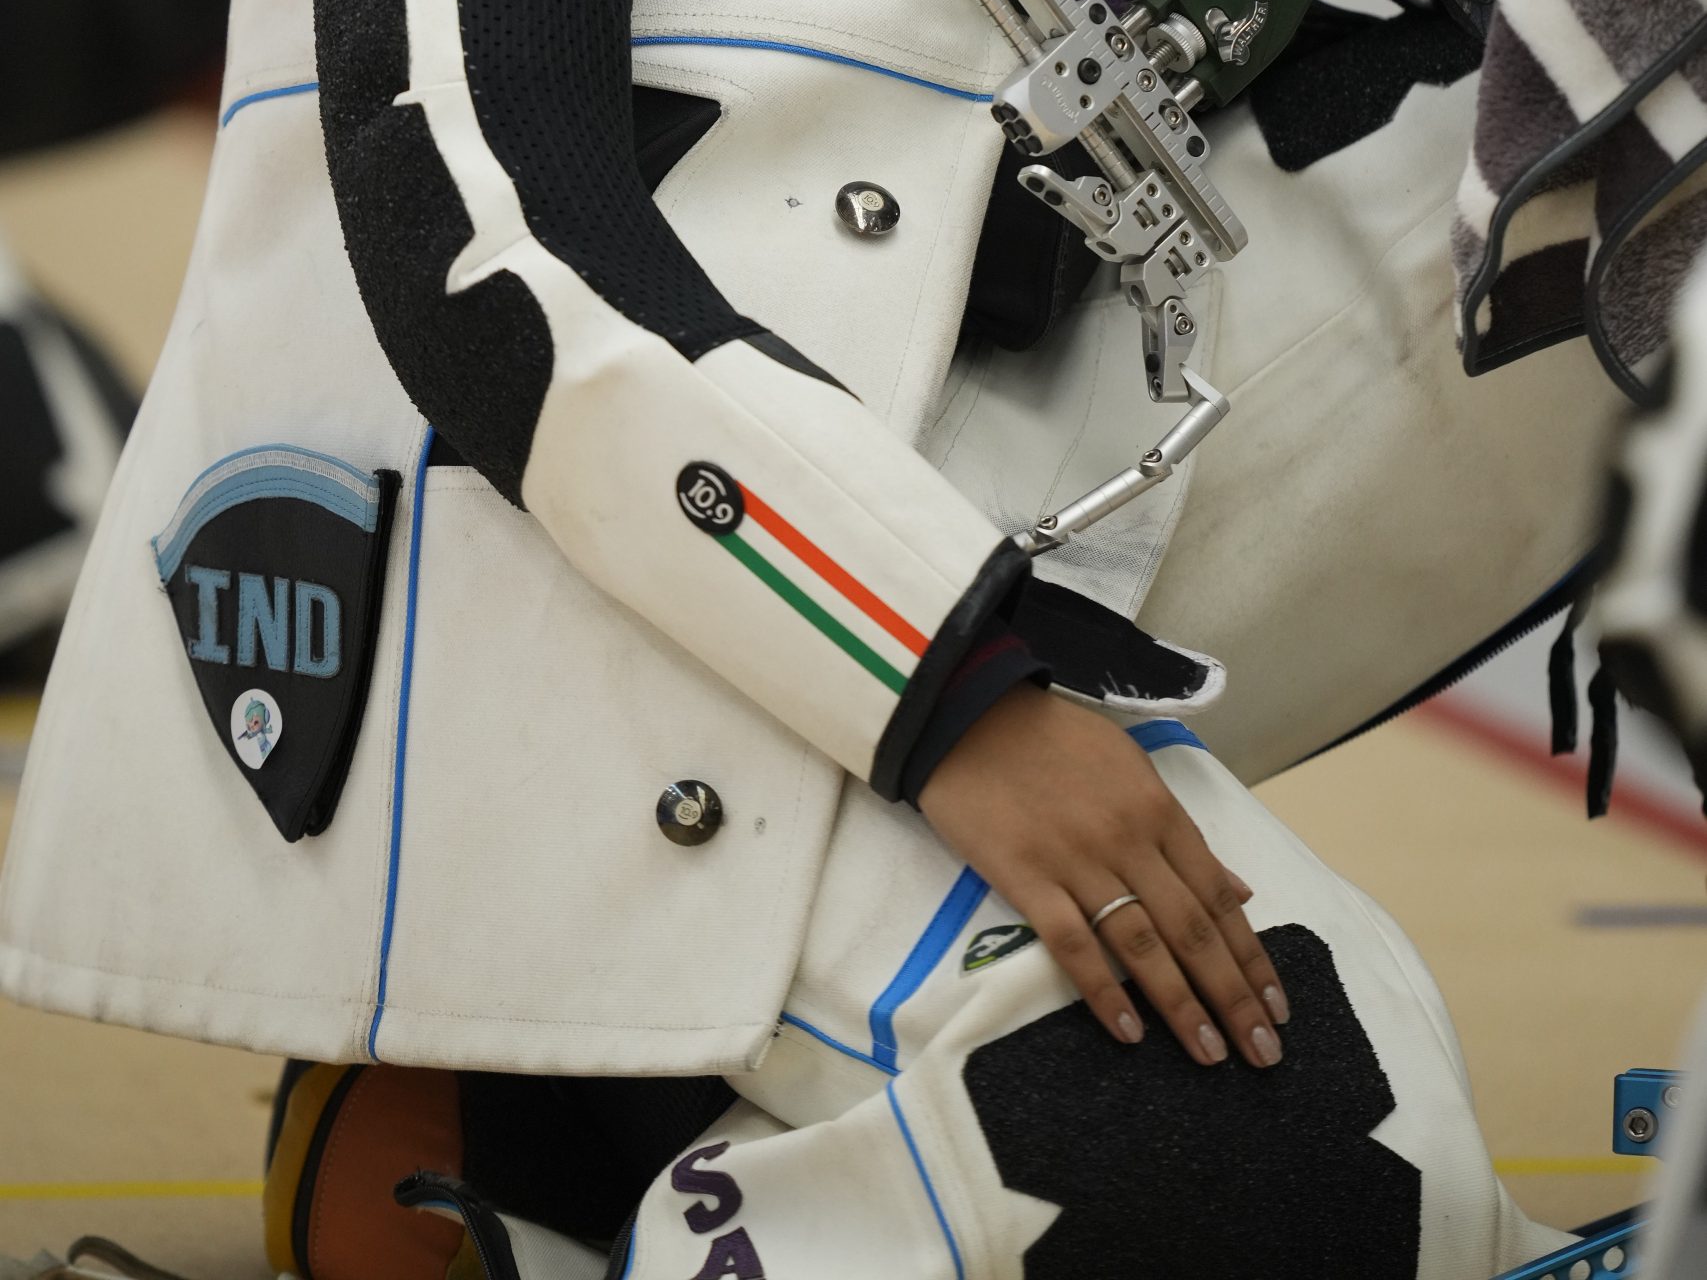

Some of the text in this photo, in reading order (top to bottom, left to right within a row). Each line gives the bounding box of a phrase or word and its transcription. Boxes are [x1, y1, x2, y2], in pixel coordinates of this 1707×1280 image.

[1233, 6, 1268, 56] WALTHER
[687, 478, 735, 525] 10.9
[185, 563, 343, 680] IND
